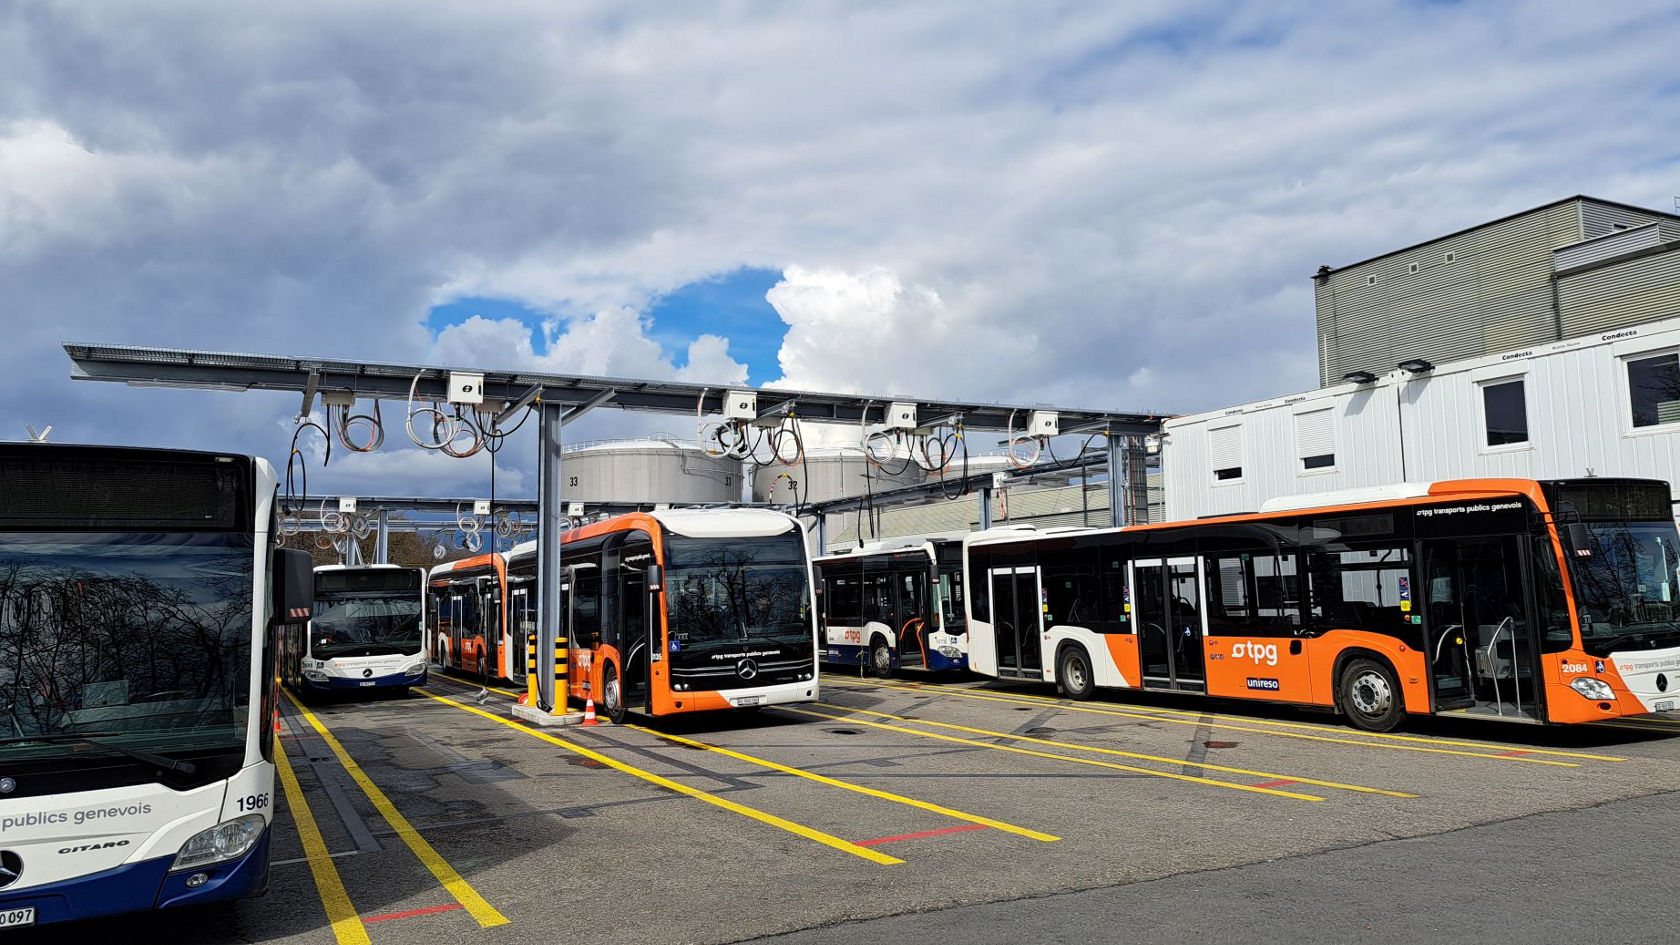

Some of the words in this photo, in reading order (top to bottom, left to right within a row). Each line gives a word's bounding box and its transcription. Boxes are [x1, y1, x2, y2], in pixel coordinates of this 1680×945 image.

[1601, 330, 1637, 341] Condecta
[1501, 350, 1533, 361] Condecta
[569, 476, 578, 487] 33
[724, 476, 732, 487] 33
[1433, 506, 1465, 515] transports
[1466, 504, 1490, 514] publics
[1491, 502, 1522, 512] genevois
[1562, 663, 1588, 673] 2084
[1247, 679, 1279, 689] unireso
[237, 792, 269, 812] 1966
[2, 811, 68, 832] publics
[74, 800, 152, 825] genevois
[58, 840, 130, 855] CITARO
[9, 909, 33, 924] 097
